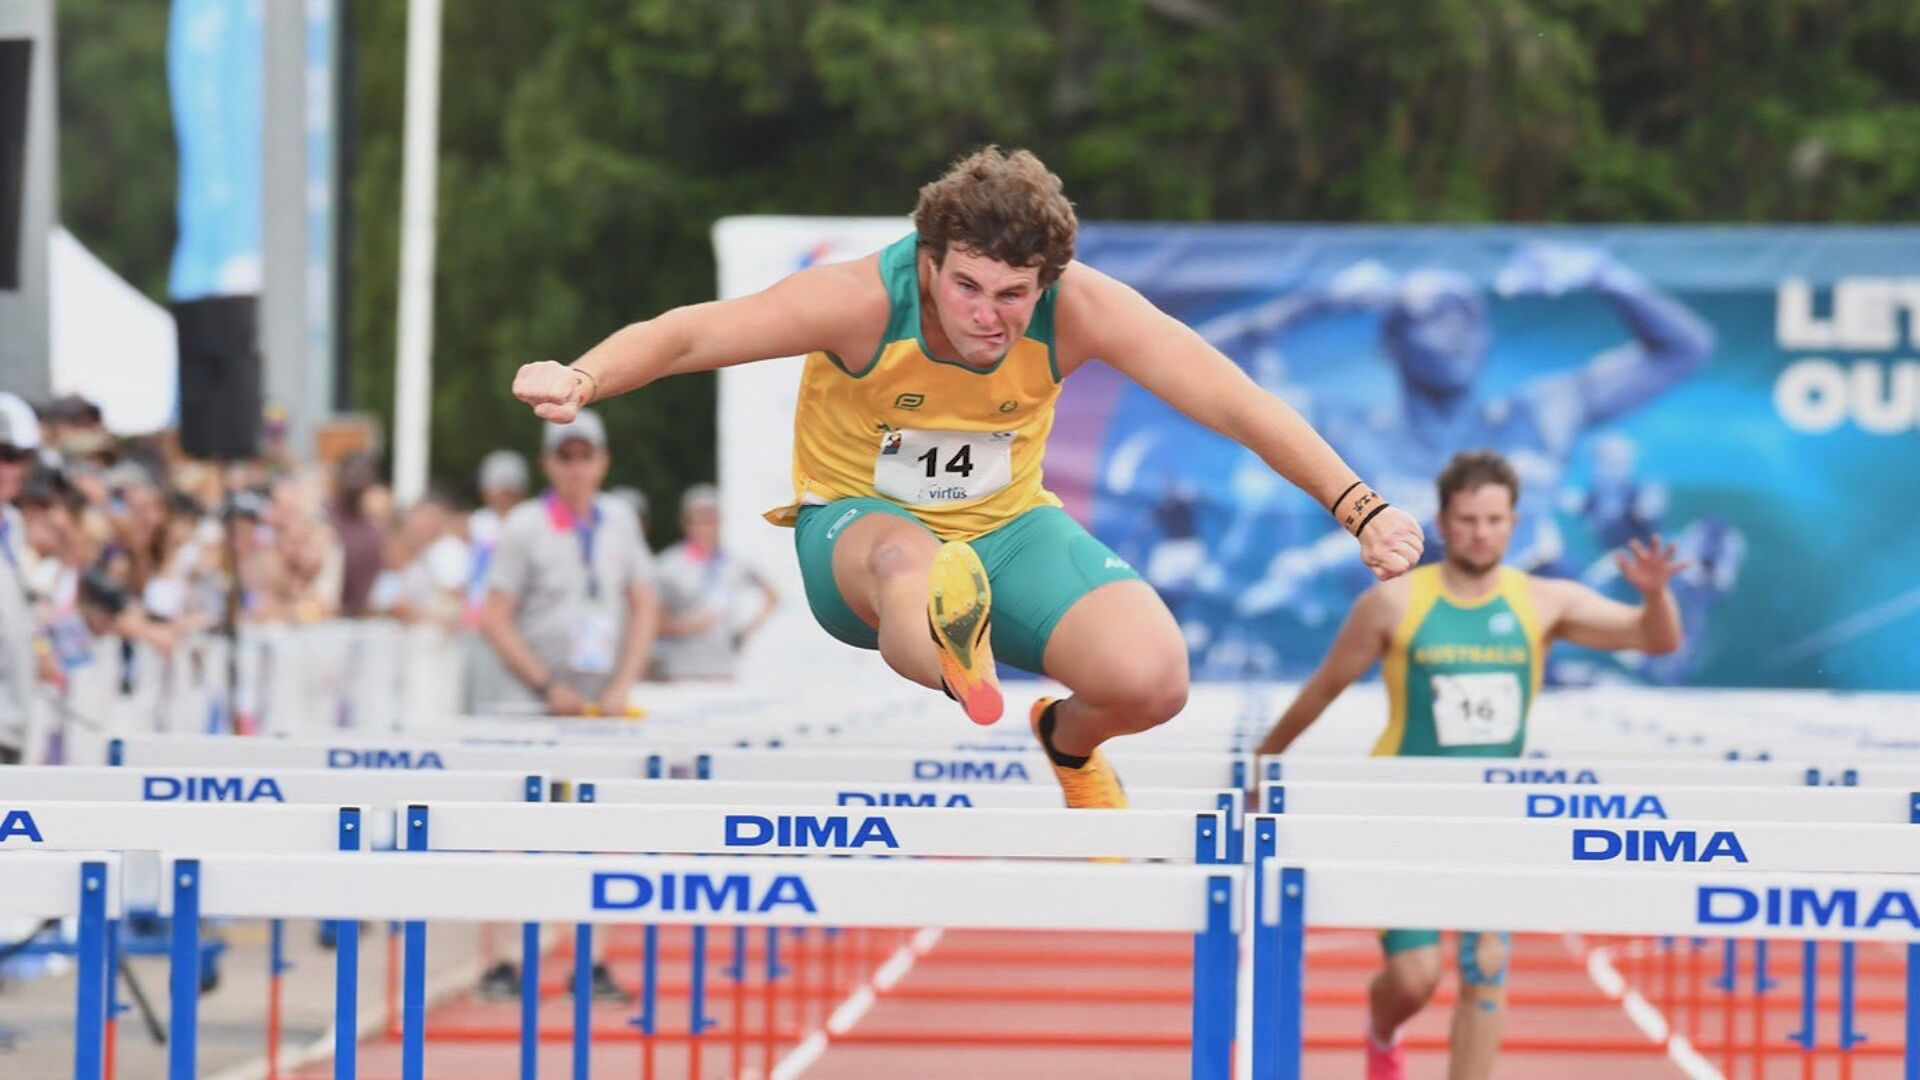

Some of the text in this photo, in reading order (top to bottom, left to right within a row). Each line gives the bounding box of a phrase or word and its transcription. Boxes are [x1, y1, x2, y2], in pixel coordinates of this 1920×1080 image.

[1773, 358, 1920, 434] OU
[918, 444, 974, 478] 14
[327, 749, 444, 770] DIMA
[913, 760, 1029, 782] DIMA
[142, 776, 285, 802] DIMA
[1526, 794, 1668, 819] DIMA
[724, 815, 899, 848] DIMA
[1572, 829, 1748, 863] DIMA
[590, 872, 818, 914] DIMA
[1697, 885, 1920, 929] DIMA
